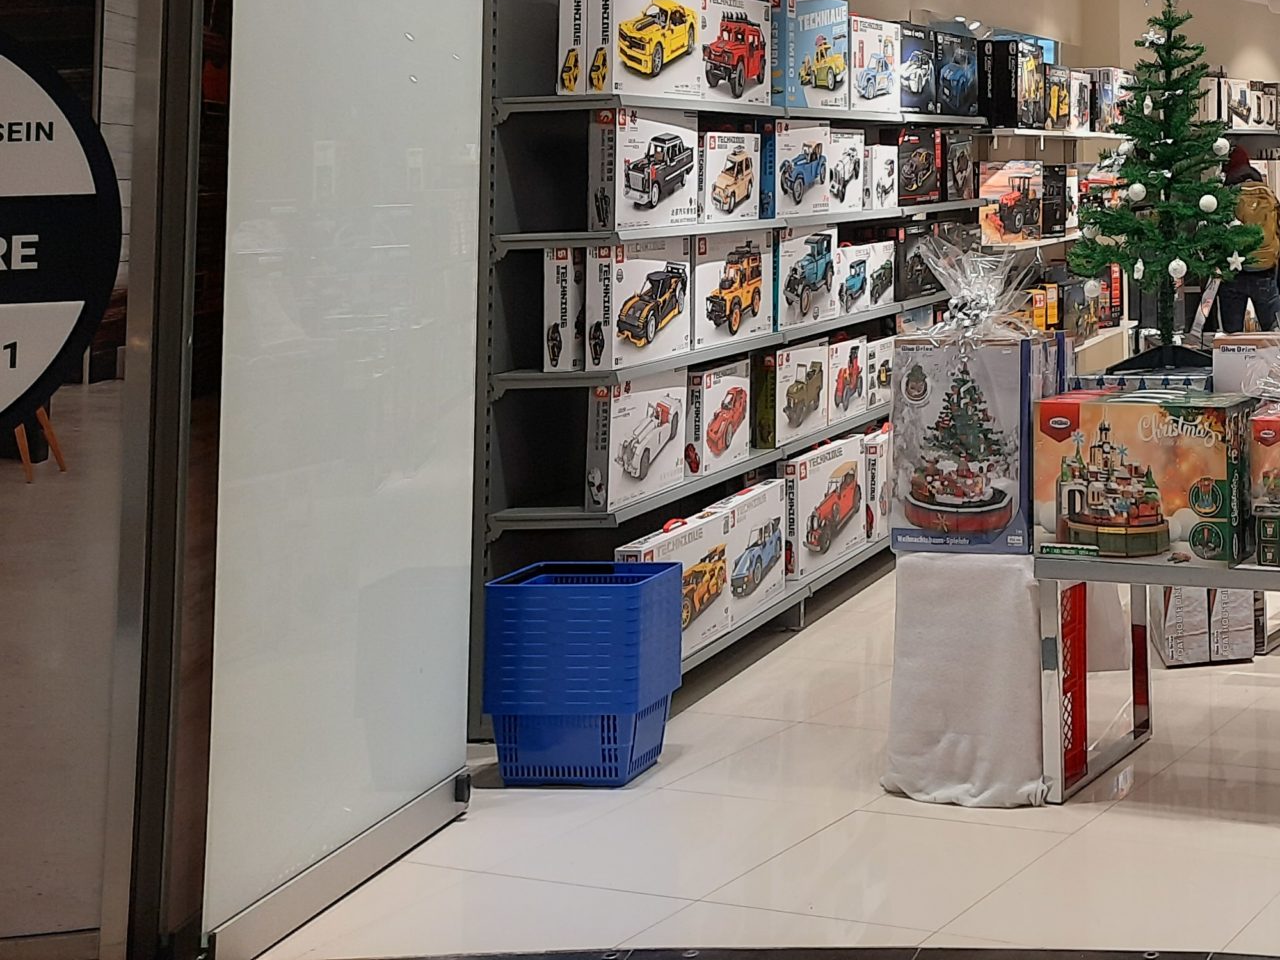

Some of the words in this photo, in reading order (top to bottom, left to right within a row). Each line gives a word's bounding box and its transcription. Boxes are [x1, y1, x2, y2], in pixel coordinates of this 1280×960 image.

[0, 121, 54, 142] EIN
[0, 234, 39, 270] E
[1138, 414, 1221, 448] Christmas
